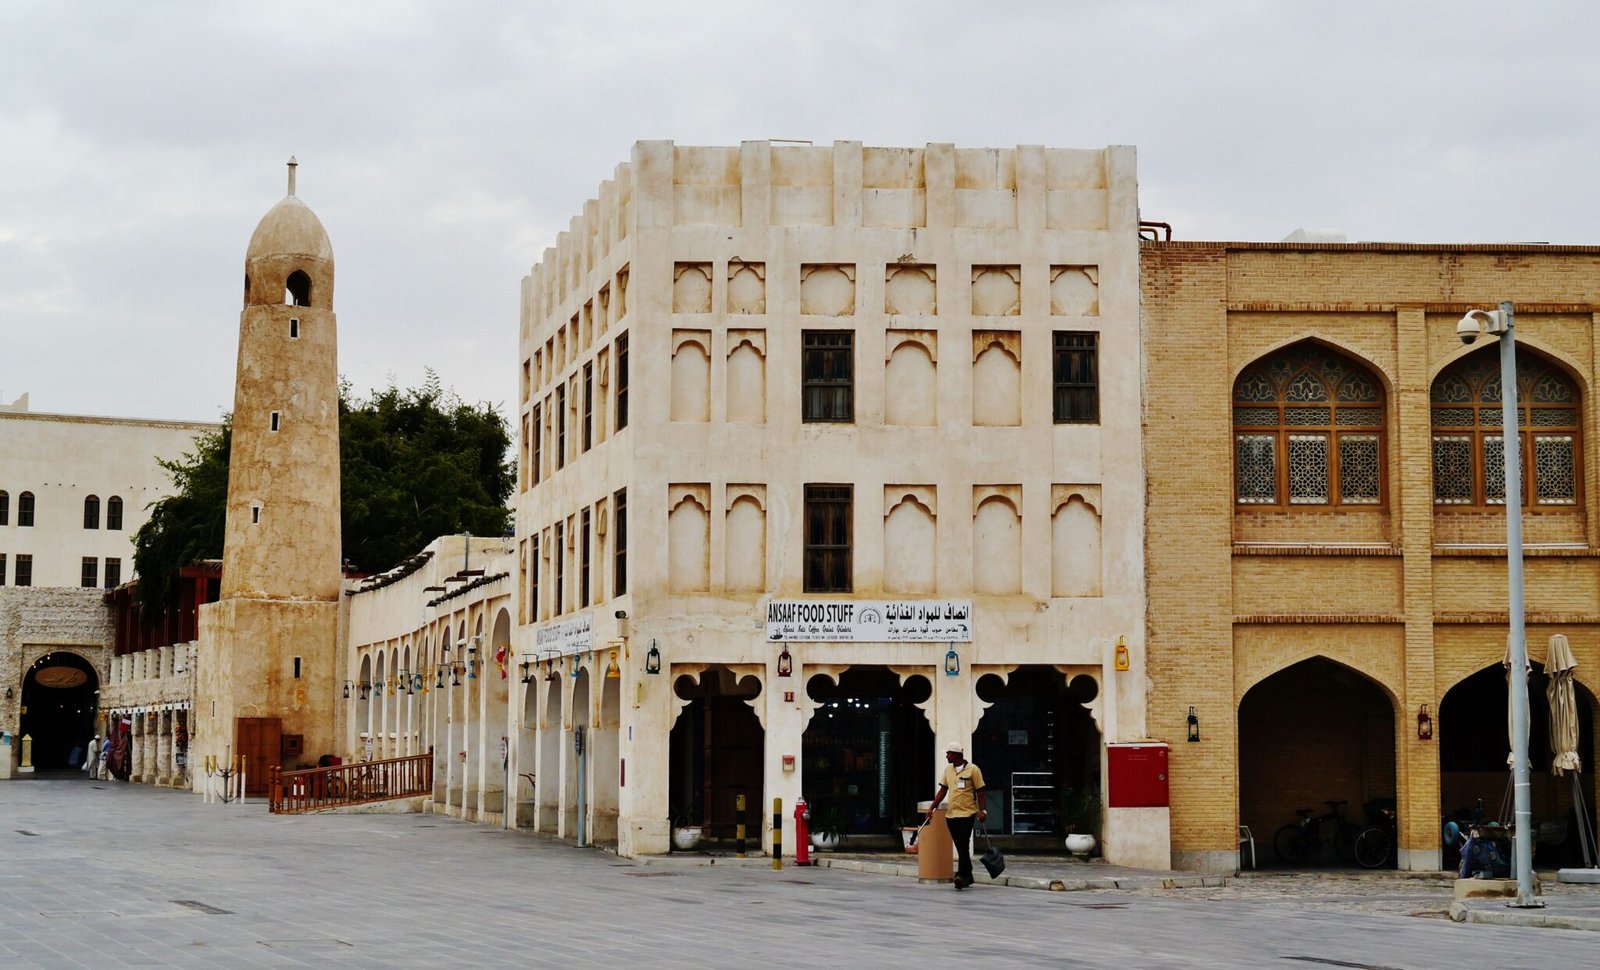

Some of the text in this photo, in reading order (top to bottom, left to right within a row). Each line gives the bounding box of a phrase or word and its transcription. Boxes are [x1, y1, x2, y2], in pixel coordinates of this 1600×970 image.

[769, 603, 853, 622] ANSAAF FOOD STUFF
[887, 602, 968, 624] انصاف للمواد الغذائية
